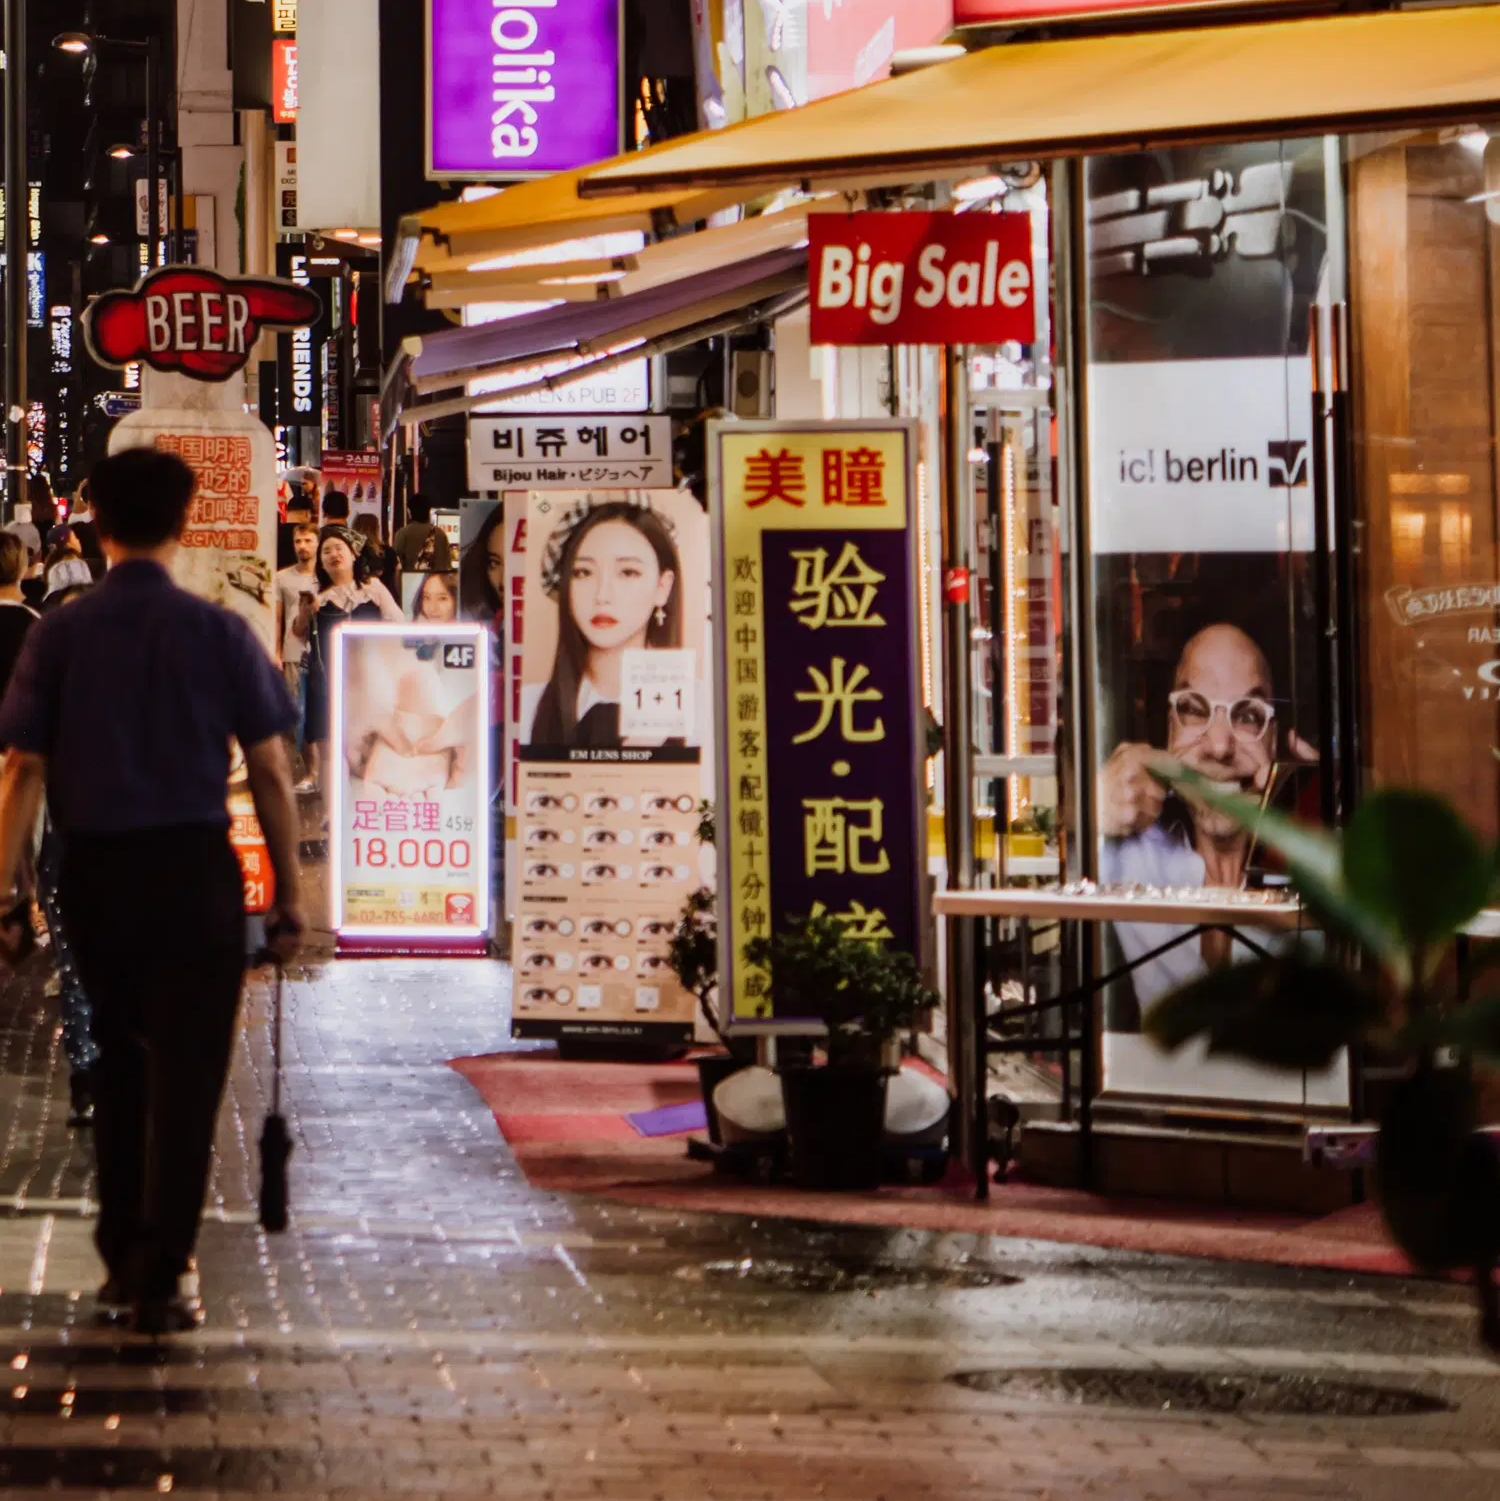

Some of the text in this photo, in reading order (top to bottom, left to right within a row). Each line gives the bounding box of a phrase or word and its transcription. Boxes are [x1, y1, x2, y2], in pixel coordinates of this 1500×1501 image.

[817, 241, 1031, 325] Big Sale
[146, 292, 250, 354] BEER
[291, 327, 311, 413] RIENDS
[580, 386, 617, 404] PUB
[622, 386, 642, 403] 2F
[492, 424, 653, 458] 비쥬헤어
[492, 468, 533, 485] Bijou
[536, 467, 568, 482] Hair
[744, 447, 888, 508] 美瞳
[1119, 447, 1259, 484] ic! berlin
[190, 495, 260, 525] 和啤酒
[445, 644, 475, 668] 4F
[569, 748, 653, 761] EM LENS SHOP
[351, 799, 474, 833] 足管理 45分
[243, 880, 266, 907] 21
